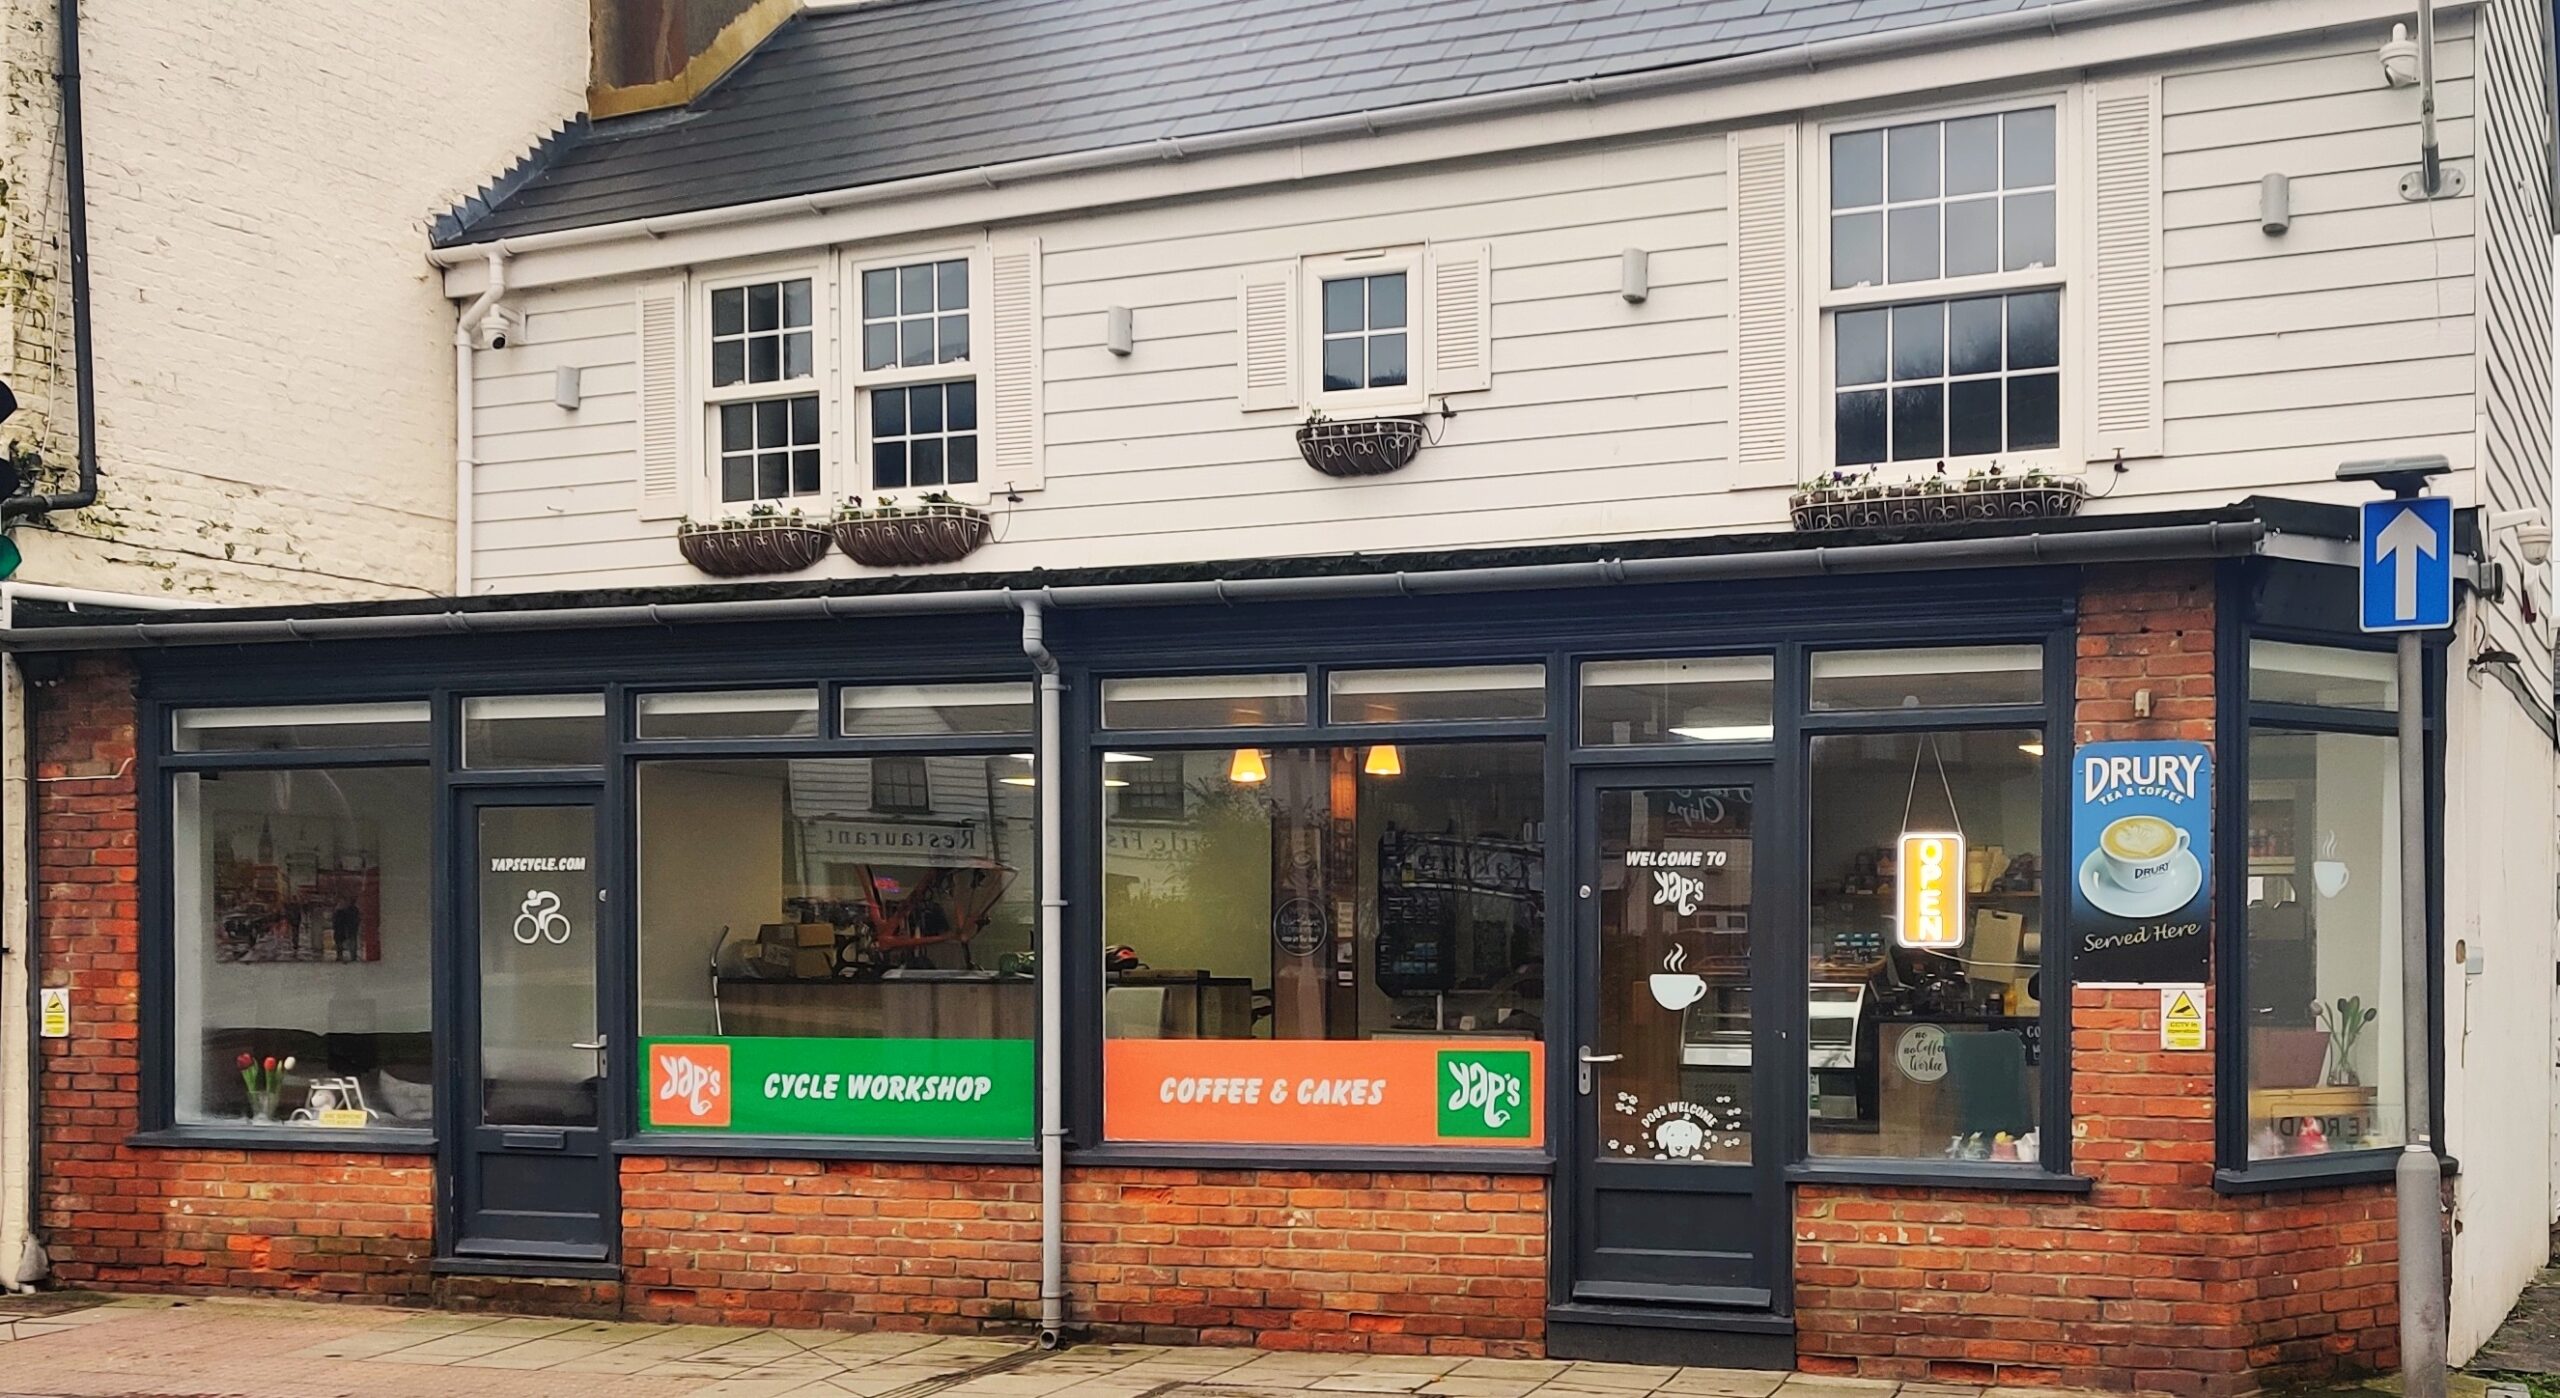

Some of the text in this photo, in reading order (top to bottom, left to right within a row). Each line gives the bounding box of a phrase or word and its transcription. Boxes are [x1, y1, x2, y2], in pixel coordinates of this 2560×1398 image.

[2085, 755, 2203, 804] DRURY
[2099, 786, 2185, 806] TEA & COFFEE
[491, 857, 586, 872] YAPSCYCLE.COM
[1626, 851, 1727, 867] WELCOME TO
[2134, 858, 2172, 880] DRURY
[1920, 839, 1943, 941] OPEN
[2083, 923, 2202, 952] Served Here
[764, 1073, 841, 1100] CYCLE
[848, 1074, 992, 1102] WORKSHOP
[1160, 1077, 1386, 1106] COFFEE & CAKES
[1667, 1101, 1718, 1128] WELCOME
